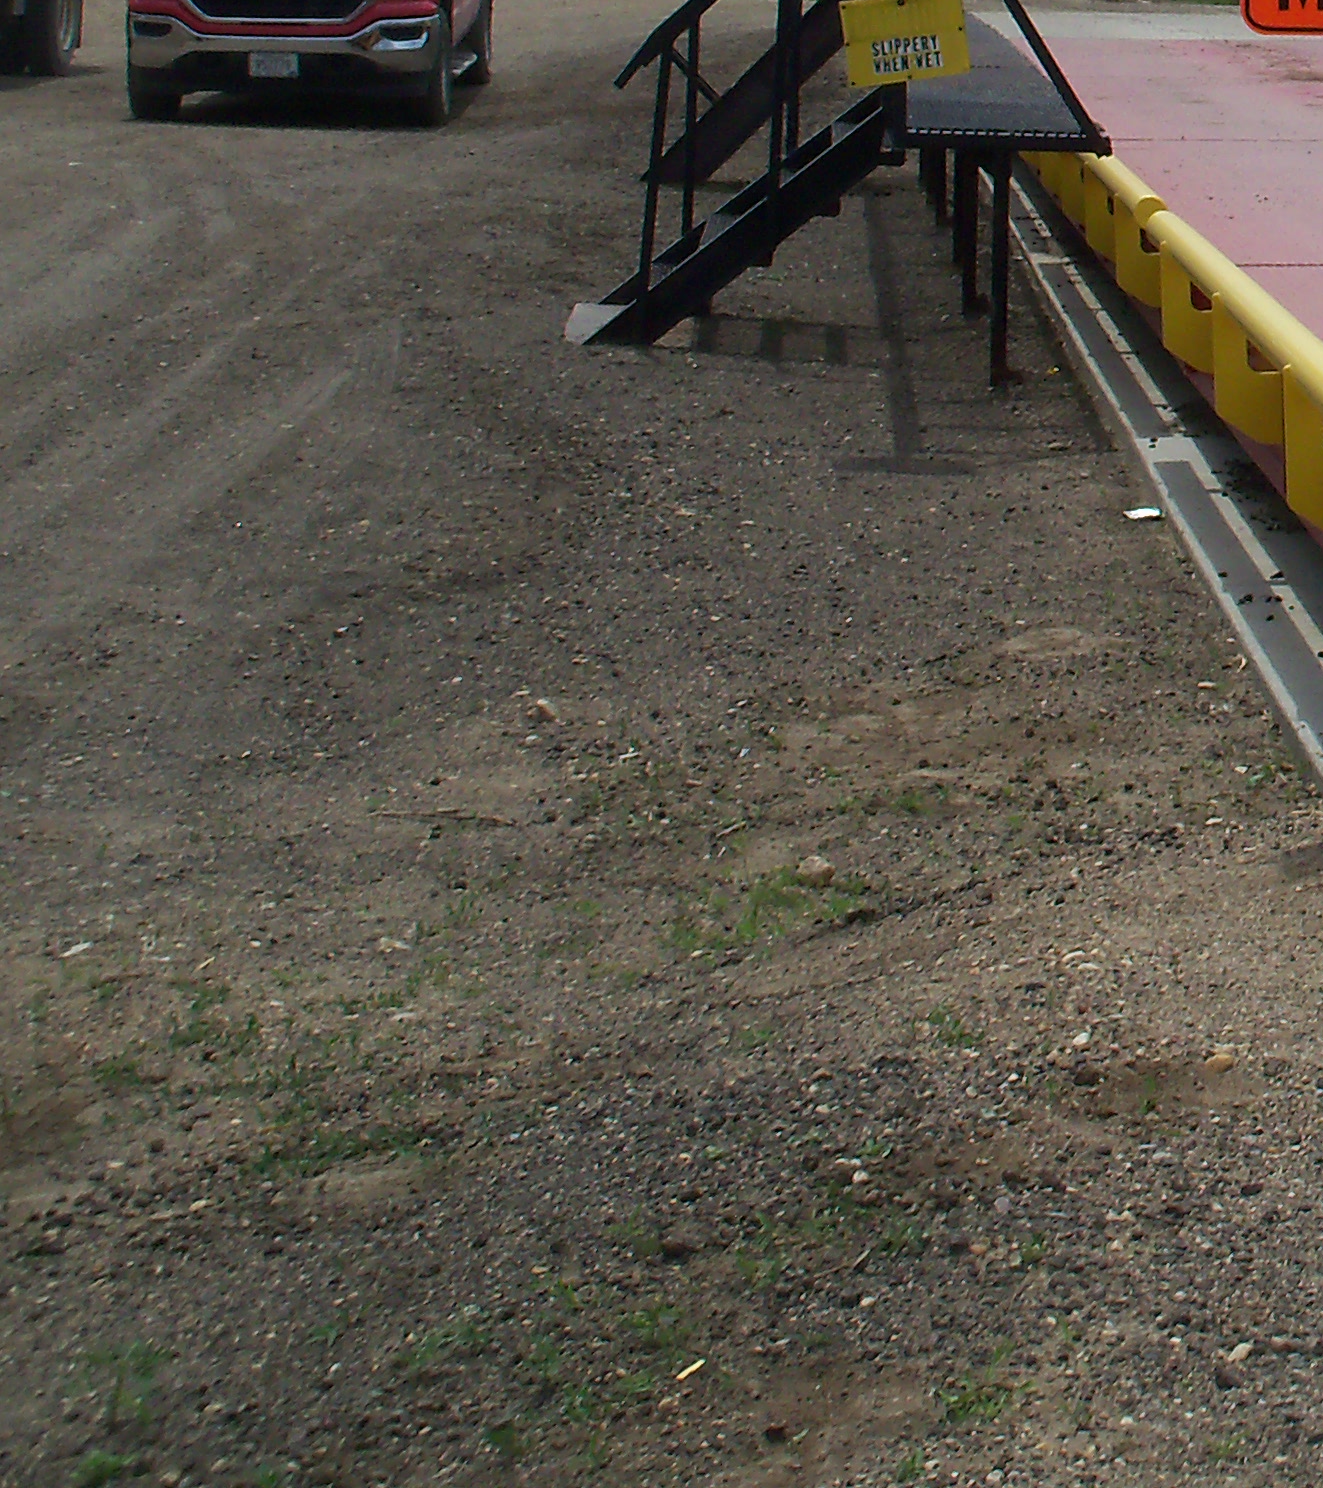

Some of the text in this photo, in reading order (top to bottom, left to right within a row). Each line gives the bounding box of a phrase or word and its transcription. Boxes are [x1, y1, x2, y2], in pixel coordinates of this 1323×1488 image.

[872, 34, 938, 57] SLIPPERY
[874, 52, 941, 73] WHEN WET
